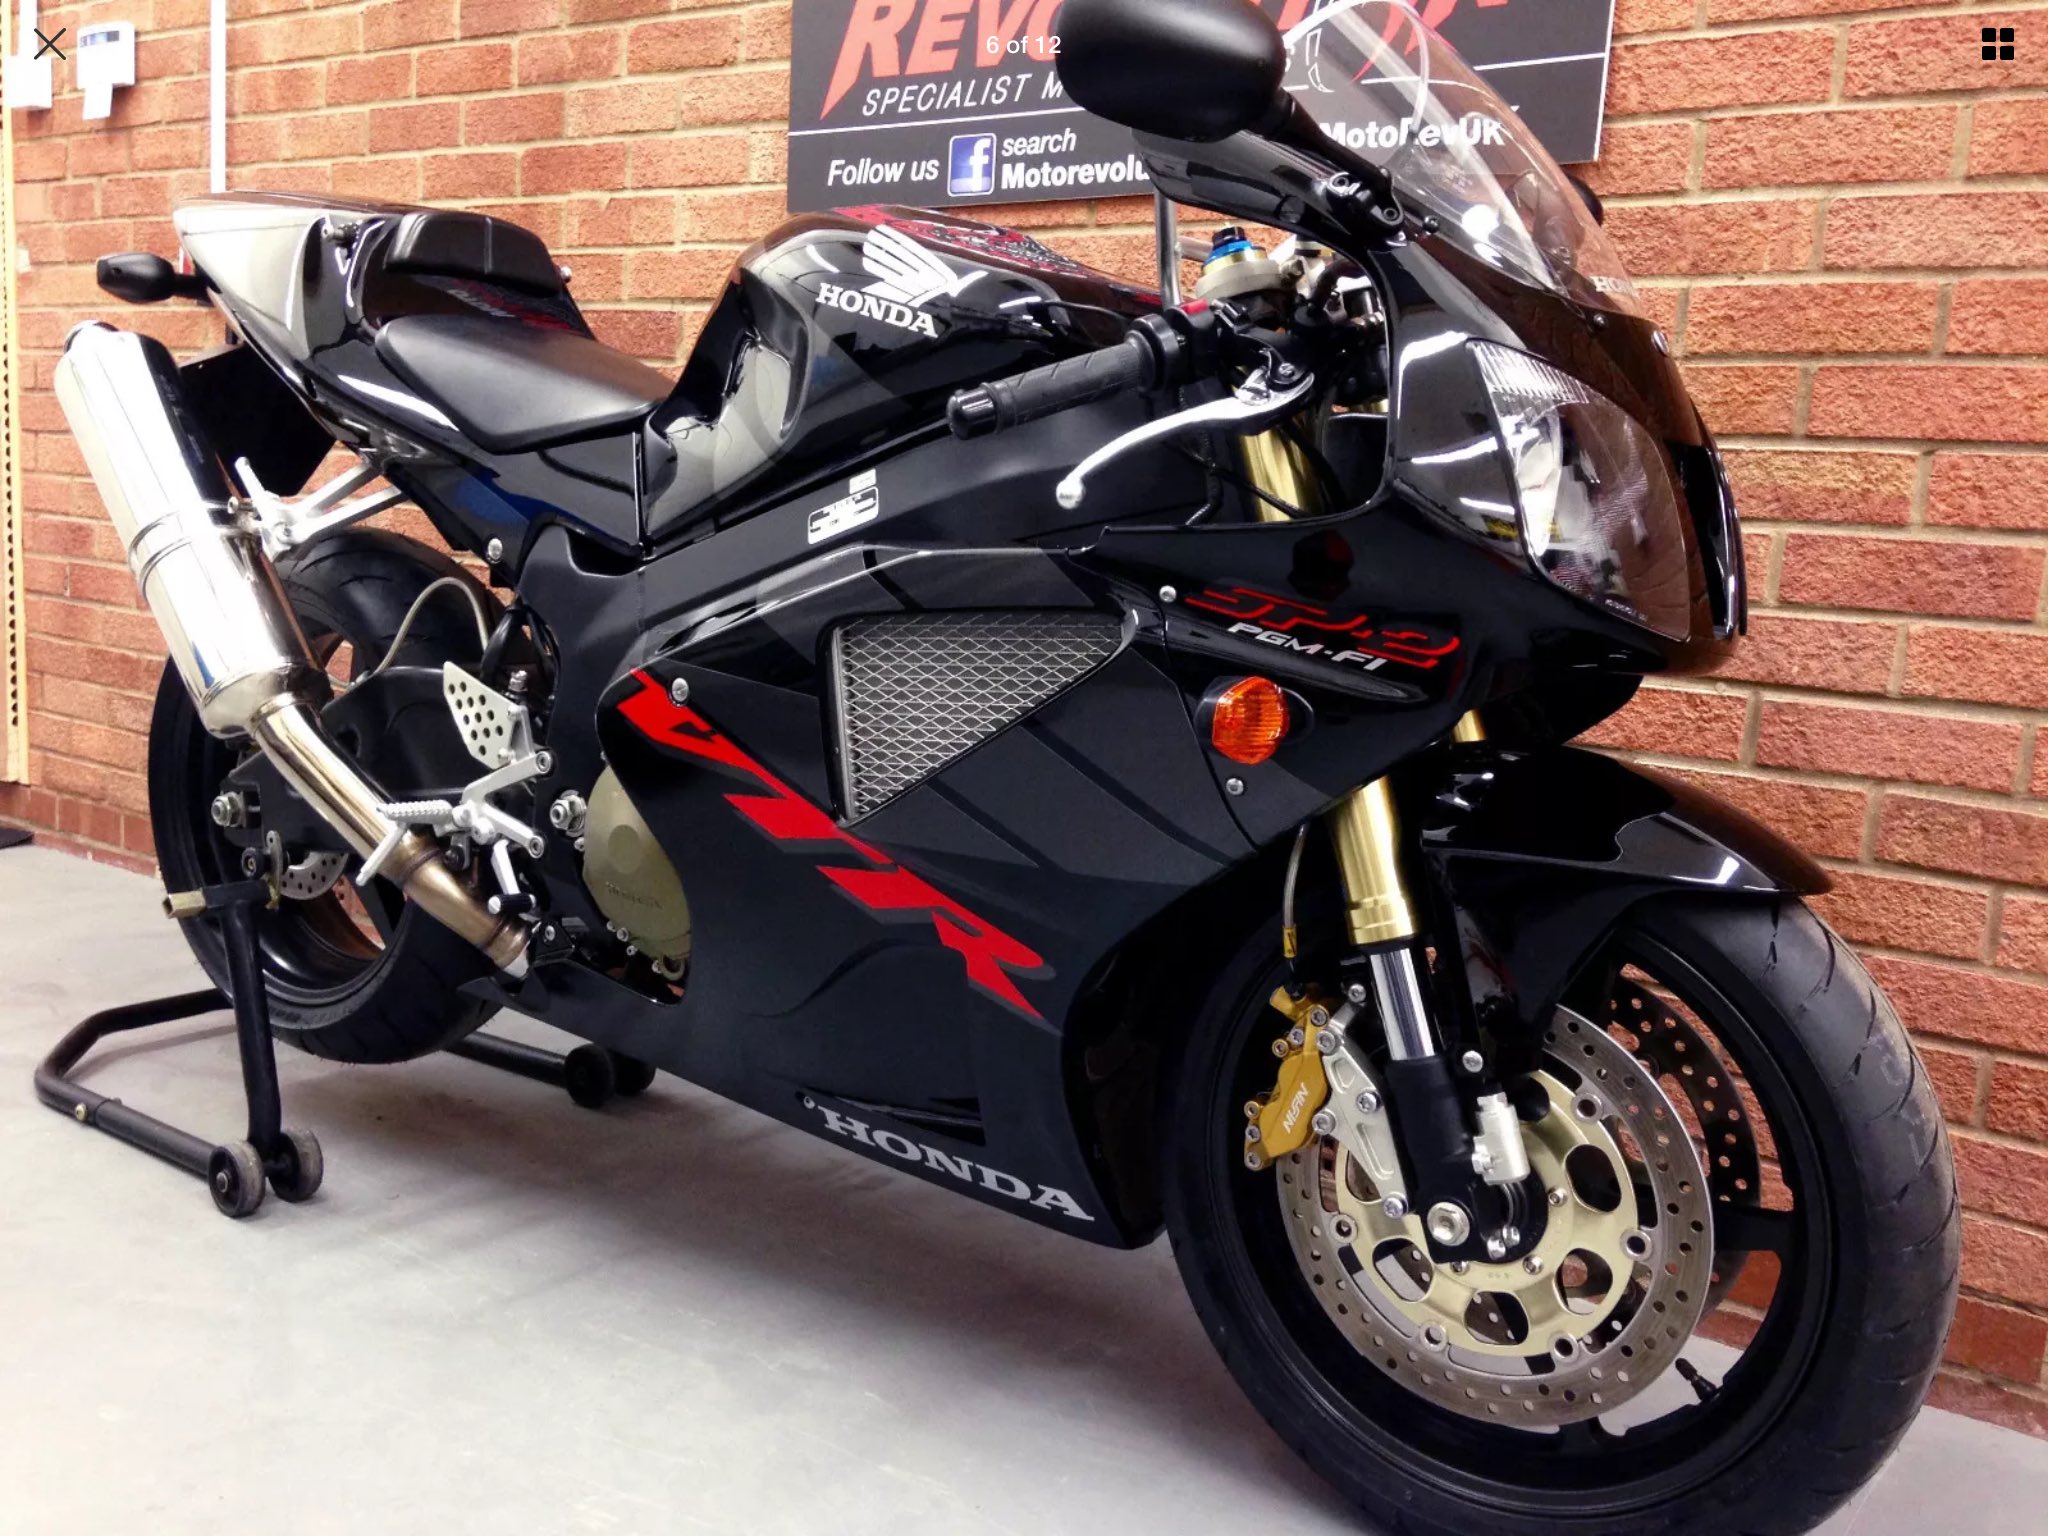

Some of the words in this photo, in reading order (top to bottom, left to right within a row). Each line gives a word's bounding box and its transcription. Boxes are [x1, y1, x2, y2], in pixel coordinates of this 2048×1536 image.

[862, 73, 1033, 117] SPECIALIST
[1001, 127, 1077, 157] search
[827, 157, 905, 187] Follow
[911, 158, 940, 182] us
[815, 282, 939, 339] HONDA
[617, 668, 1045, 1019] VTR
[817, 1105, 1096, 1222] HONDA
